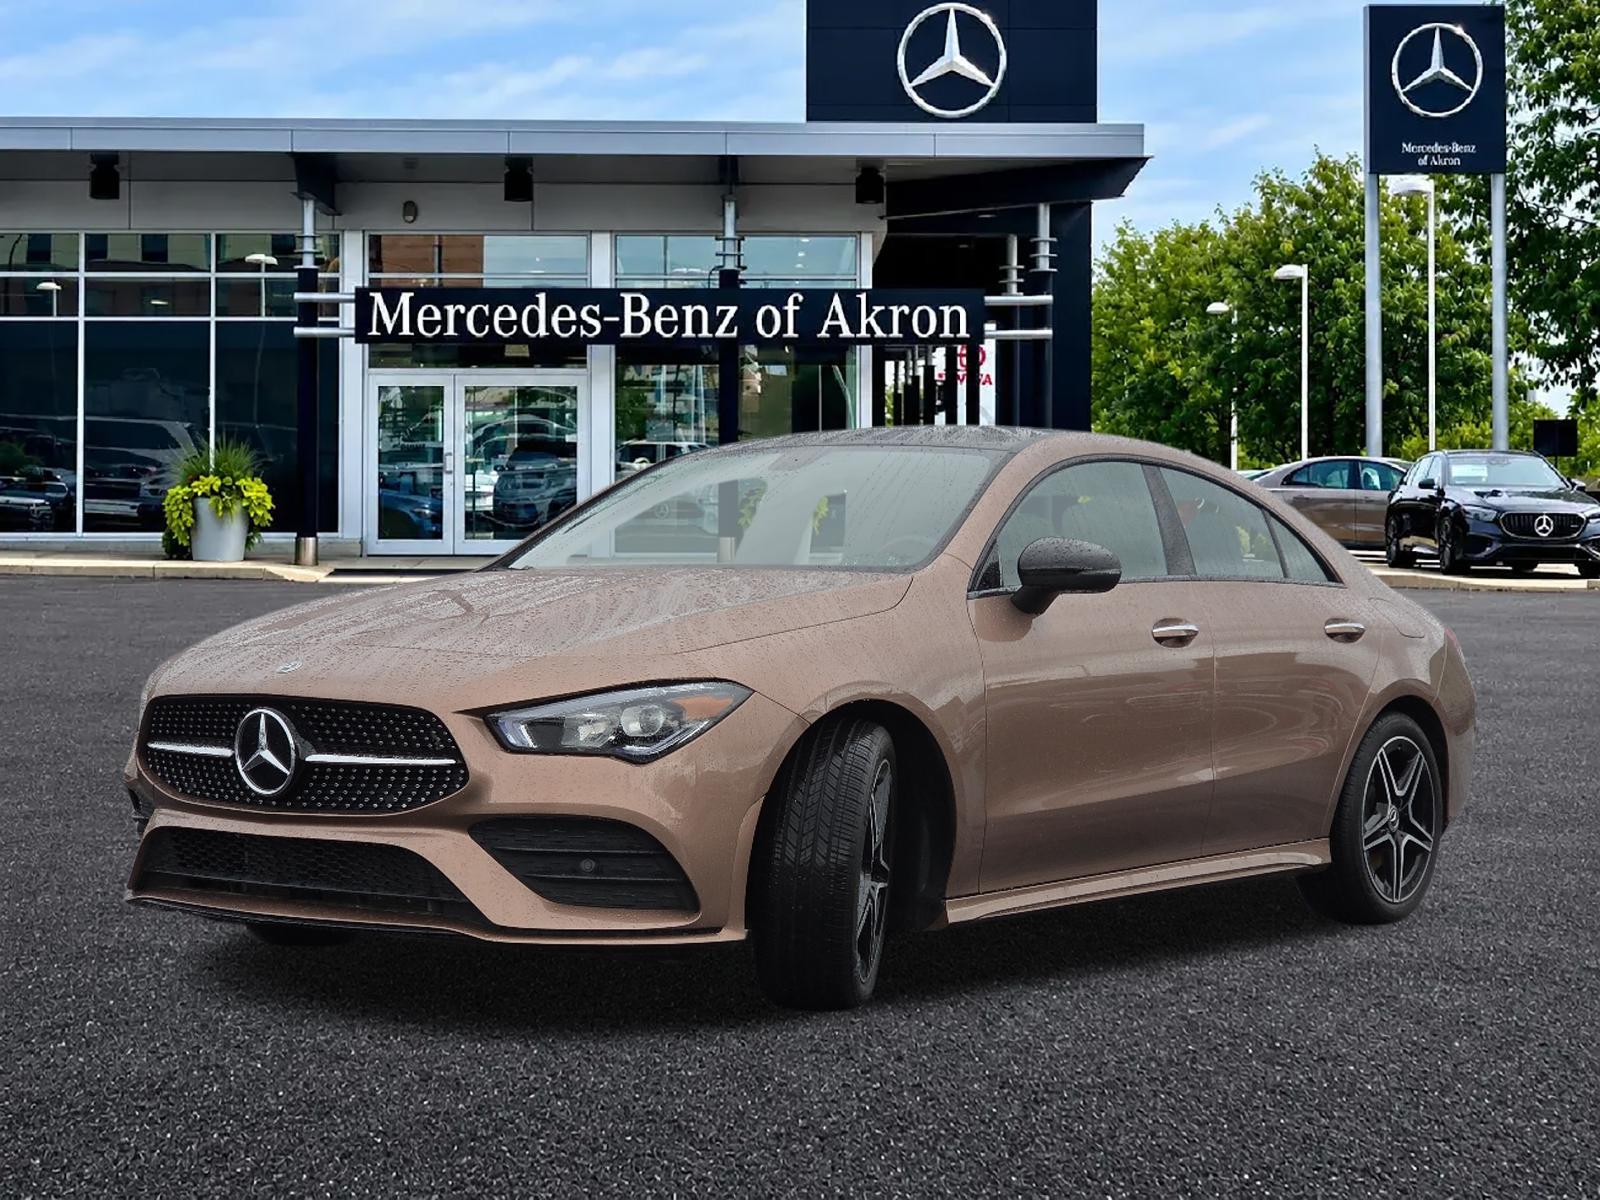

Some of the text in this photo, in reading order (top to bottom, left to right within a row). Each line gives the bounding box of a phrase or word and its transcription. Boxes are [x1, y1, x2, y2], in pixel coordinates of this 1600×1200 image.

[1401, 141, 1477, 154] Mercedes-Benz
[1417, 154, 1461, 166] of Akron
[367, 291, 971, 338] Mercedes-Benz of Akron
